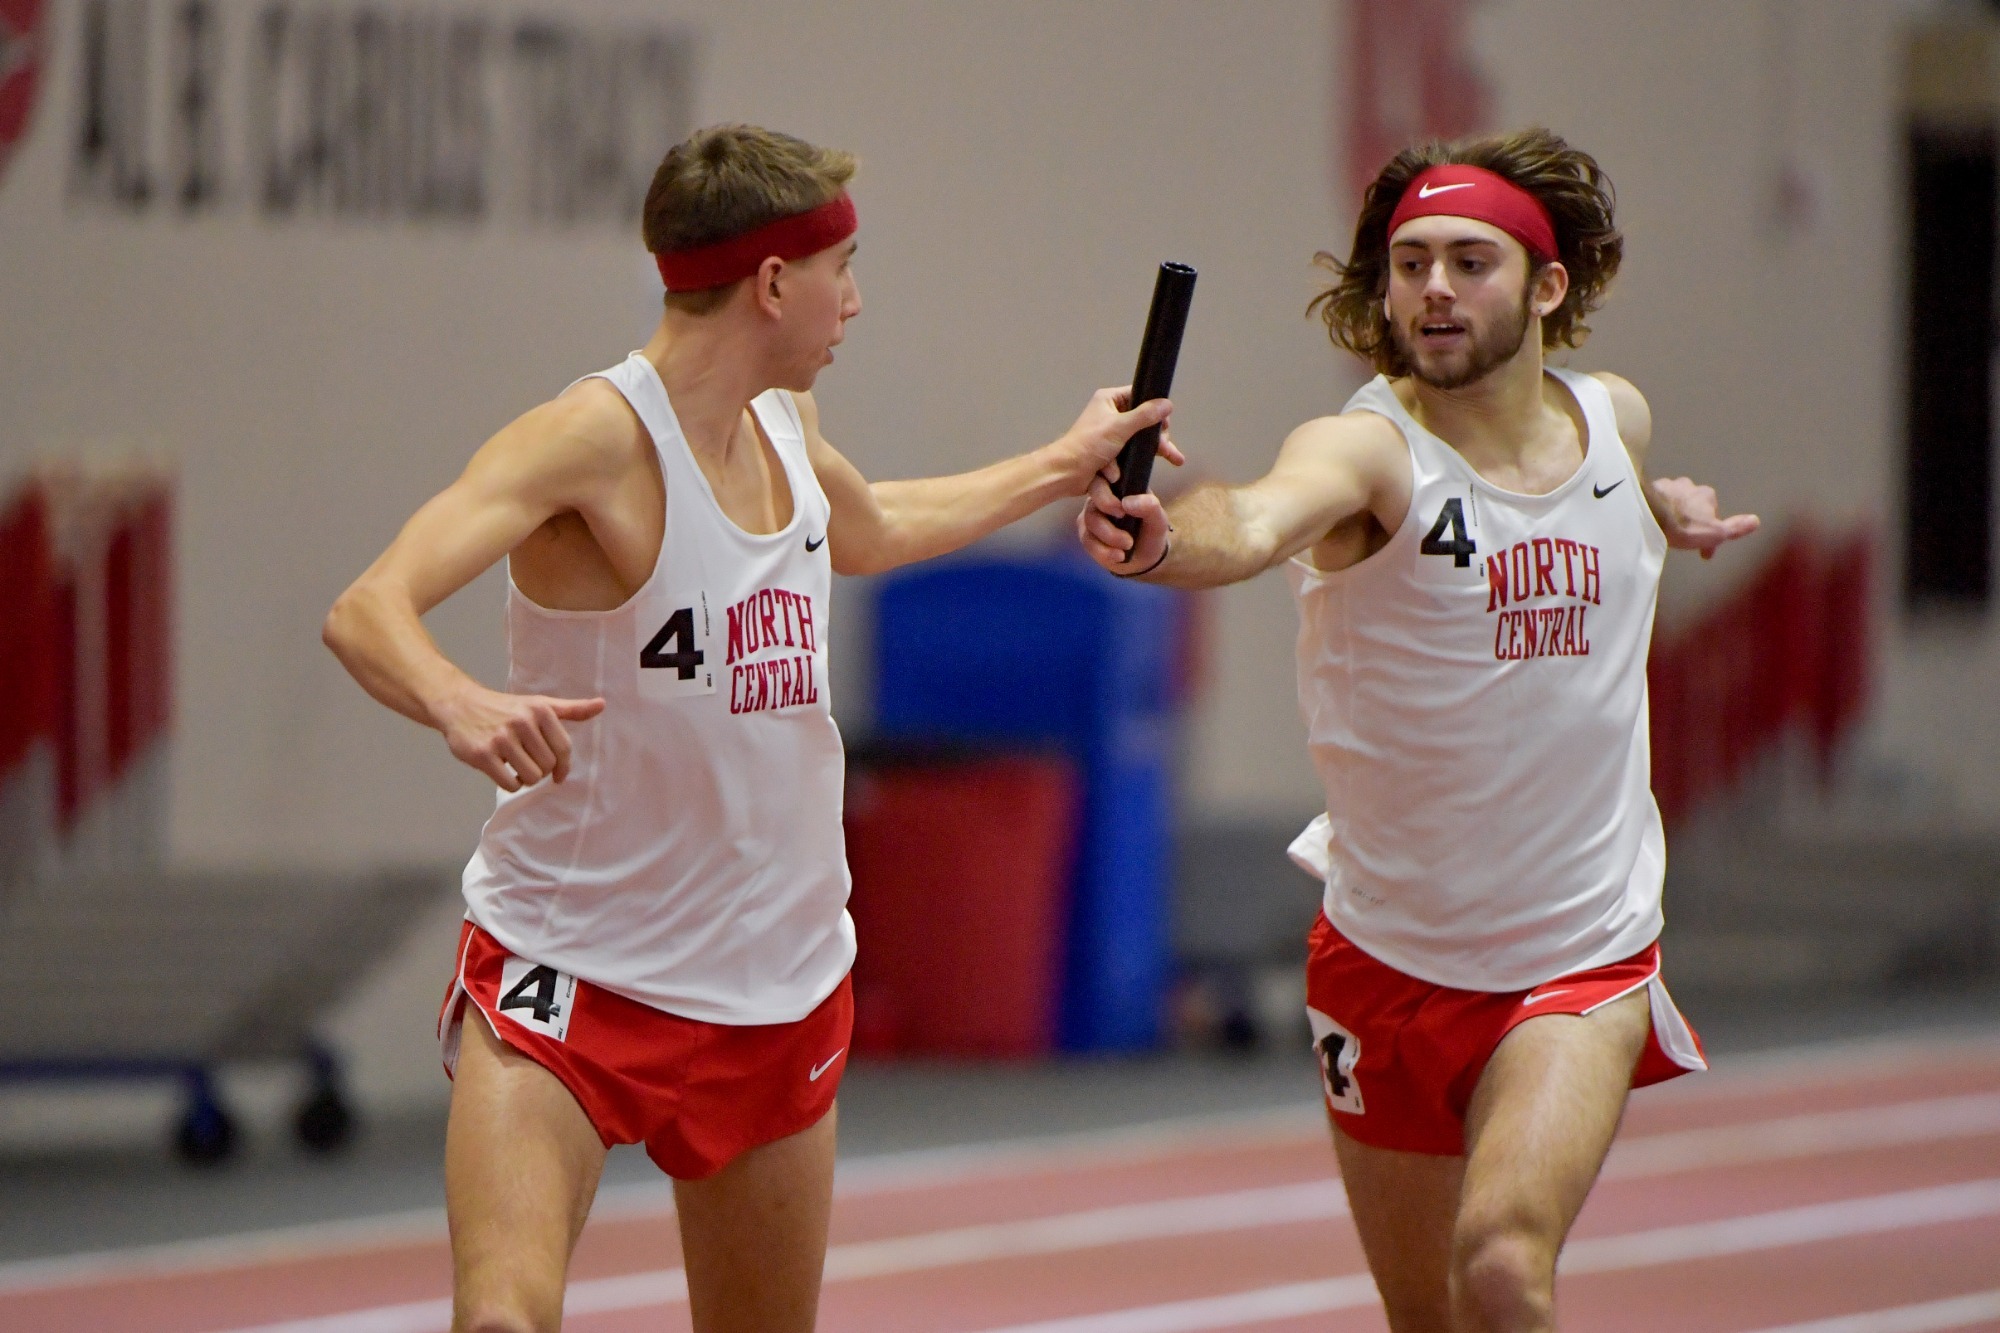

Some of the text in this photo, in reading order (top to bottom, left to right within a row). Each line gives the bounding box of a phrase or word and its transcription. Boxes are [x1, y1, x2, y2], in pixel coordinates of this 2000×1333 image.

[1420, 497, 1477, 568] 4
[1486, 537, 1601, 613] NORTH
[639, 607, 704, 680] 4
[726, 588, 817, 666] NORTH
[1494, 605, 1590, 661] CENTRAL
[729, 655, 818, 715] CENTRAL
[499, 964, 561, 1024] 4
